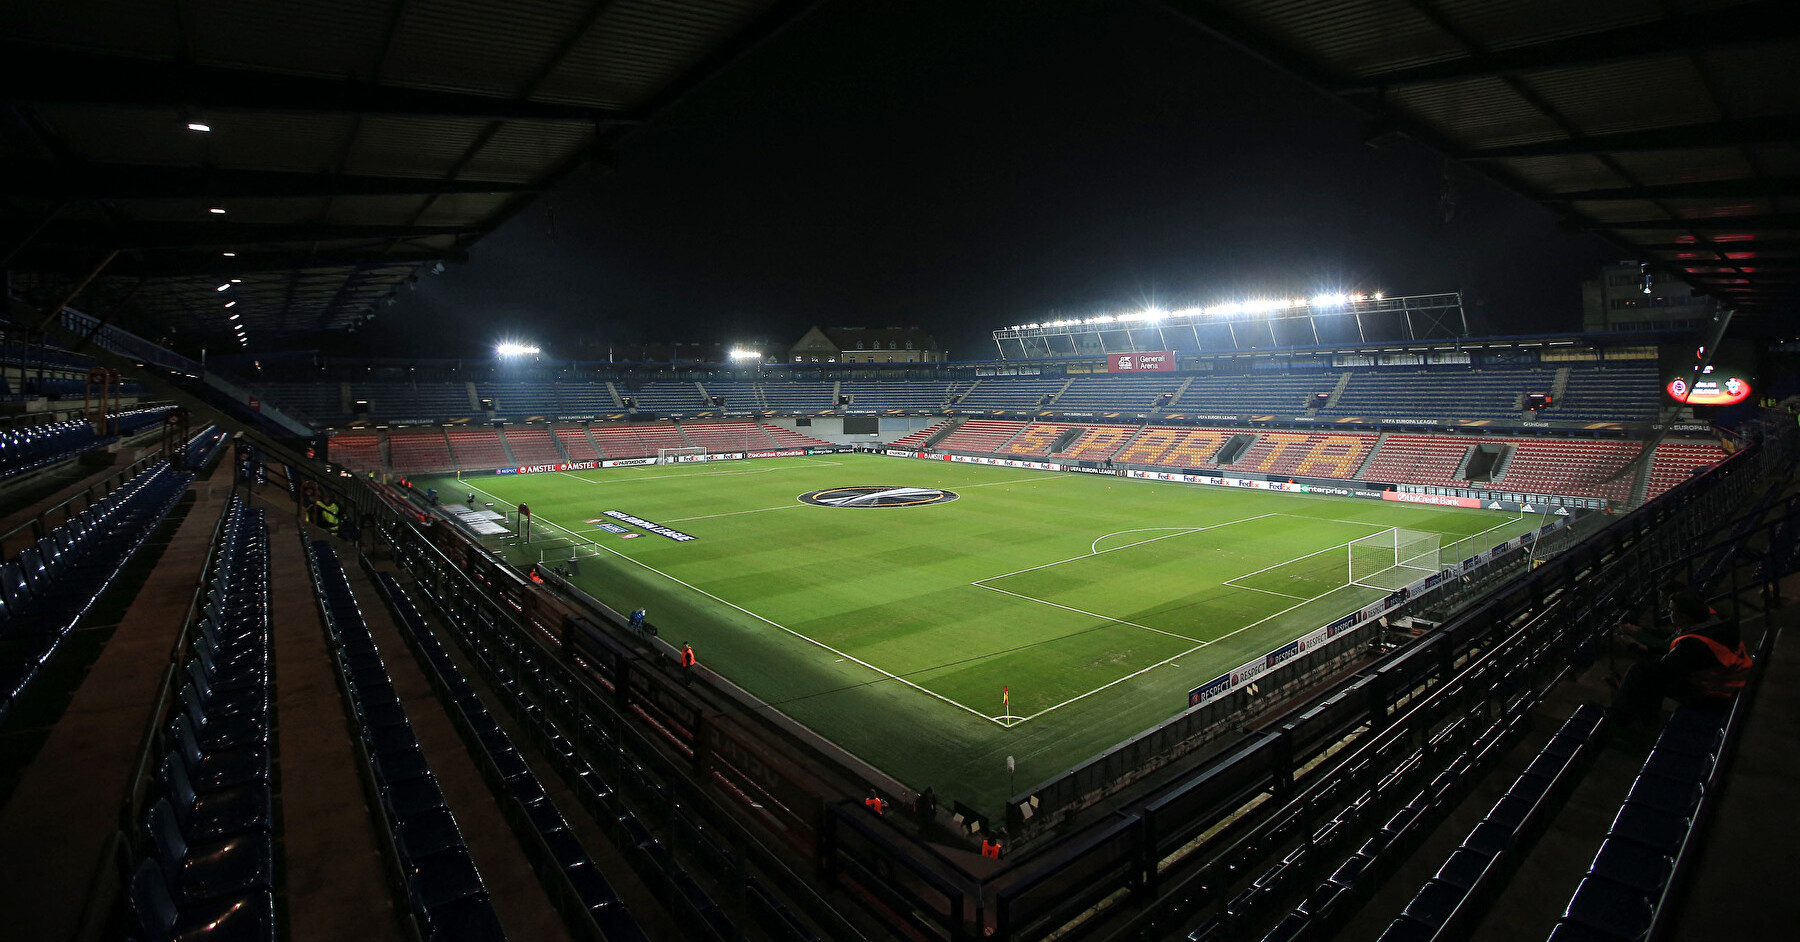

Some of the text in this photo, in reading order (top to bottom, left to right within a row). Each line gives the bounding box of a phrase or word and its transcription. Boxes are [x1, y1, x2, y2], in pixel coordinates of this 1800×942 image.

[526, 464, 556, 474] AMSTEL
[568, 461, 595, 470] AMSTEL
[1134, 470, 1150, 478] FedEx
[1158, 472, 1176, 480] FedEx
[1184, 474, 1202, 482] FedEx
[1210, 477, 1230, 486] FedEx
[1239, 480, 1260, 488] FedEx
[1268, 482, 1290, 490] FedEx
[1301, 485, 1348, 496] enterprise
[1406, 494, 1460, 506] UniCredit Bank
[1368, 604, 1385, 618] RESPECT
[1334, 619, 1354, 634] RESPECT
[1306, 632, 1328, 650] RESPECT
[1274, 646, 1298, 666] RESPECT
[1240, 662, 1266, 682] RESPECT
[1200, 680, 1230, 702] RESPECT
